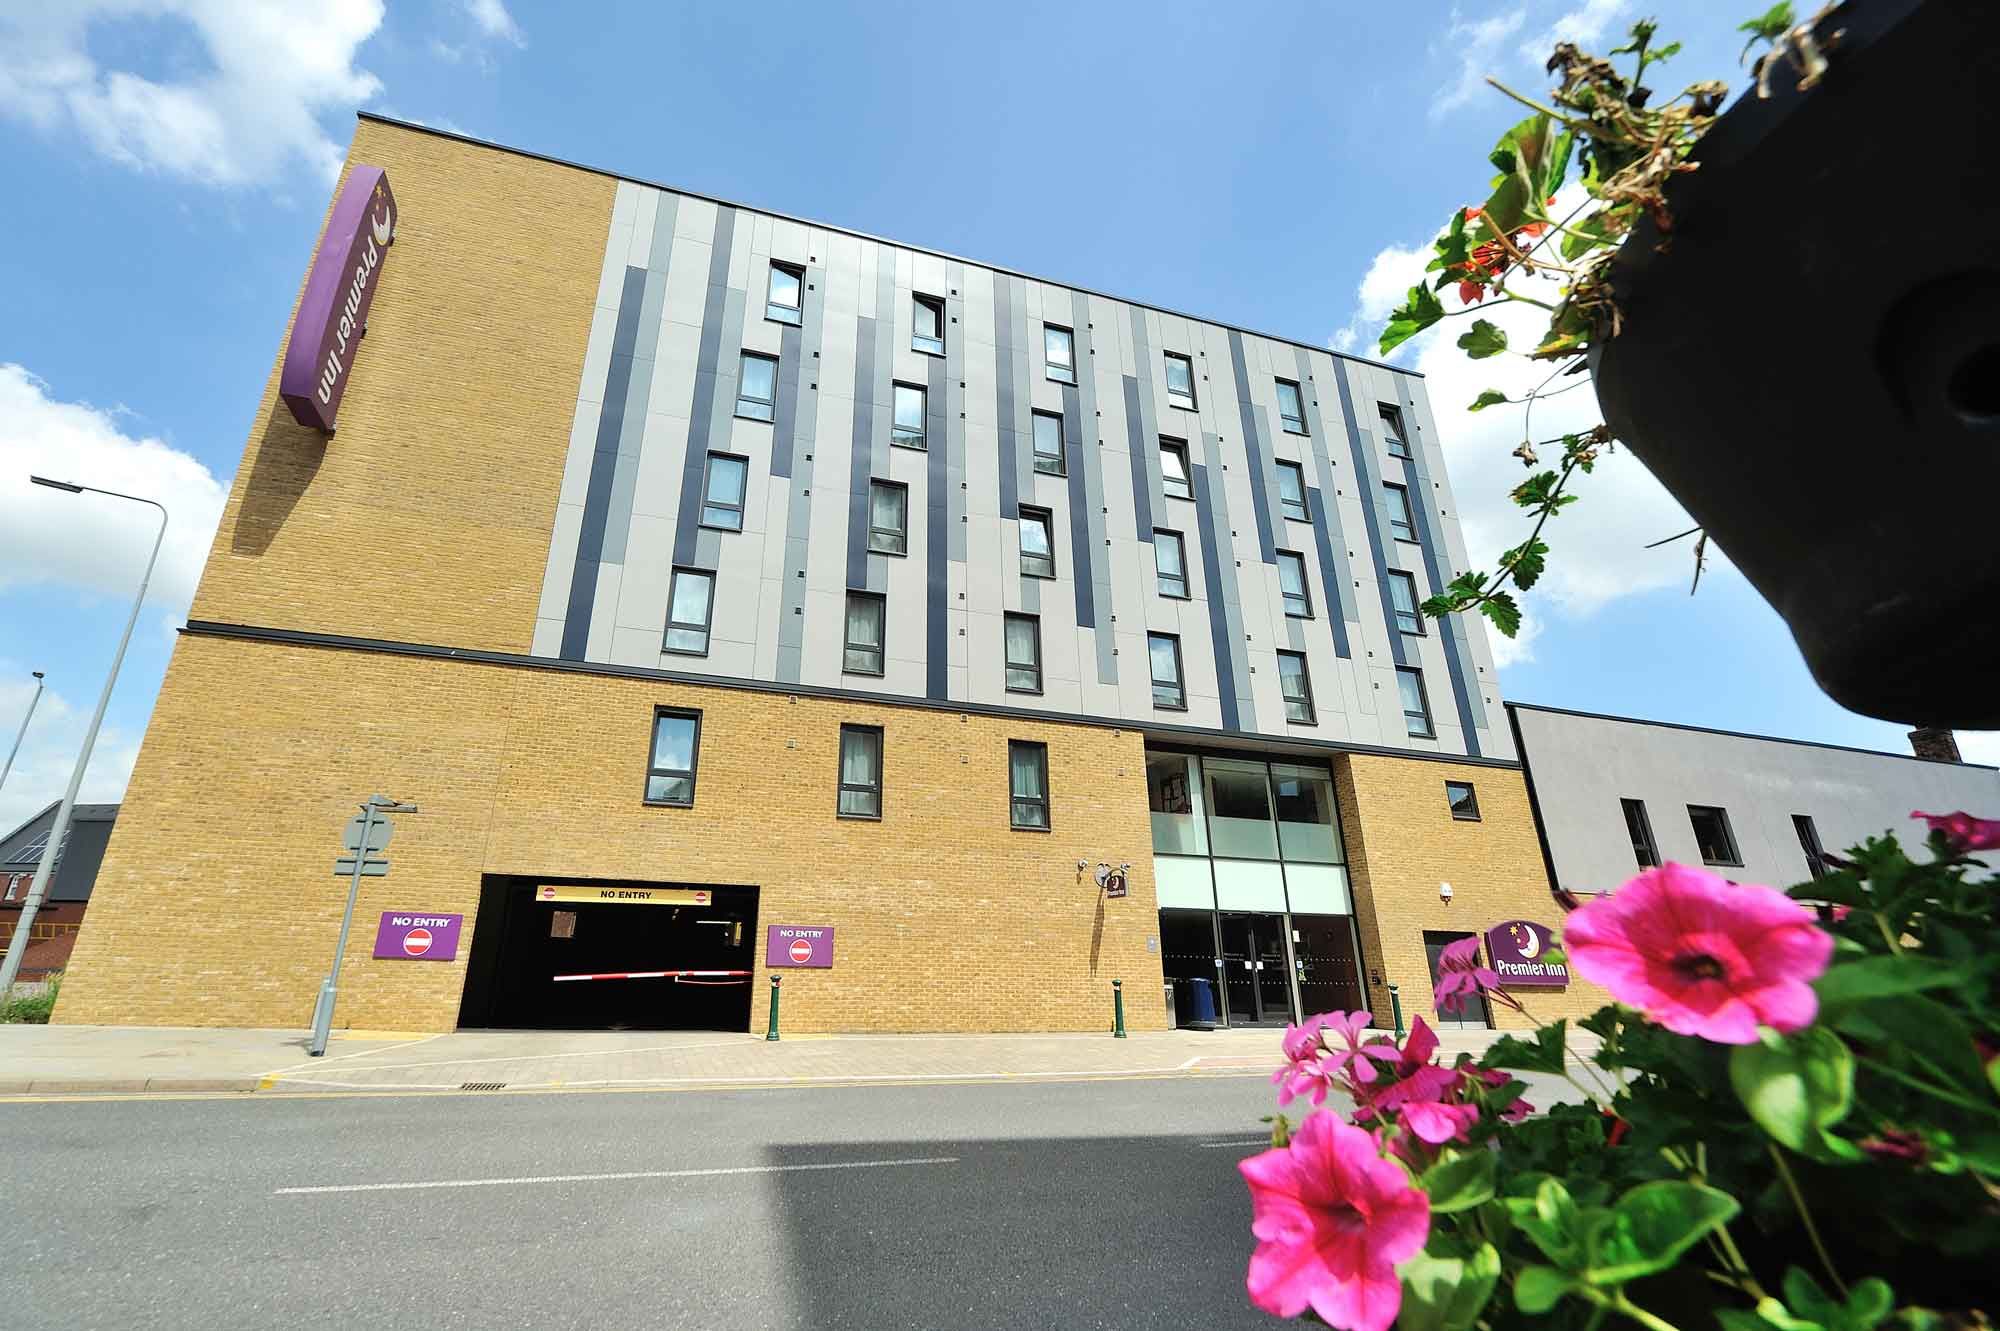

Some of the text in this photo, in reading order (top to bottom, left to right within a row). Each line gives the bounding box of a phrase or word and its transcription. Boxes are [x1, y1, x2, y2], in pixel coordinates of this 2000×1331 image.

[318, 235, 378, 404] Premier Inn
[600, 890, 652, 899] NO ENTRY
[392, 917, 451, 927] NO ENTRY
[780, 929, 823, 938] NO ENTRY
[1496, 959, 1566, 976] Premier Inn
